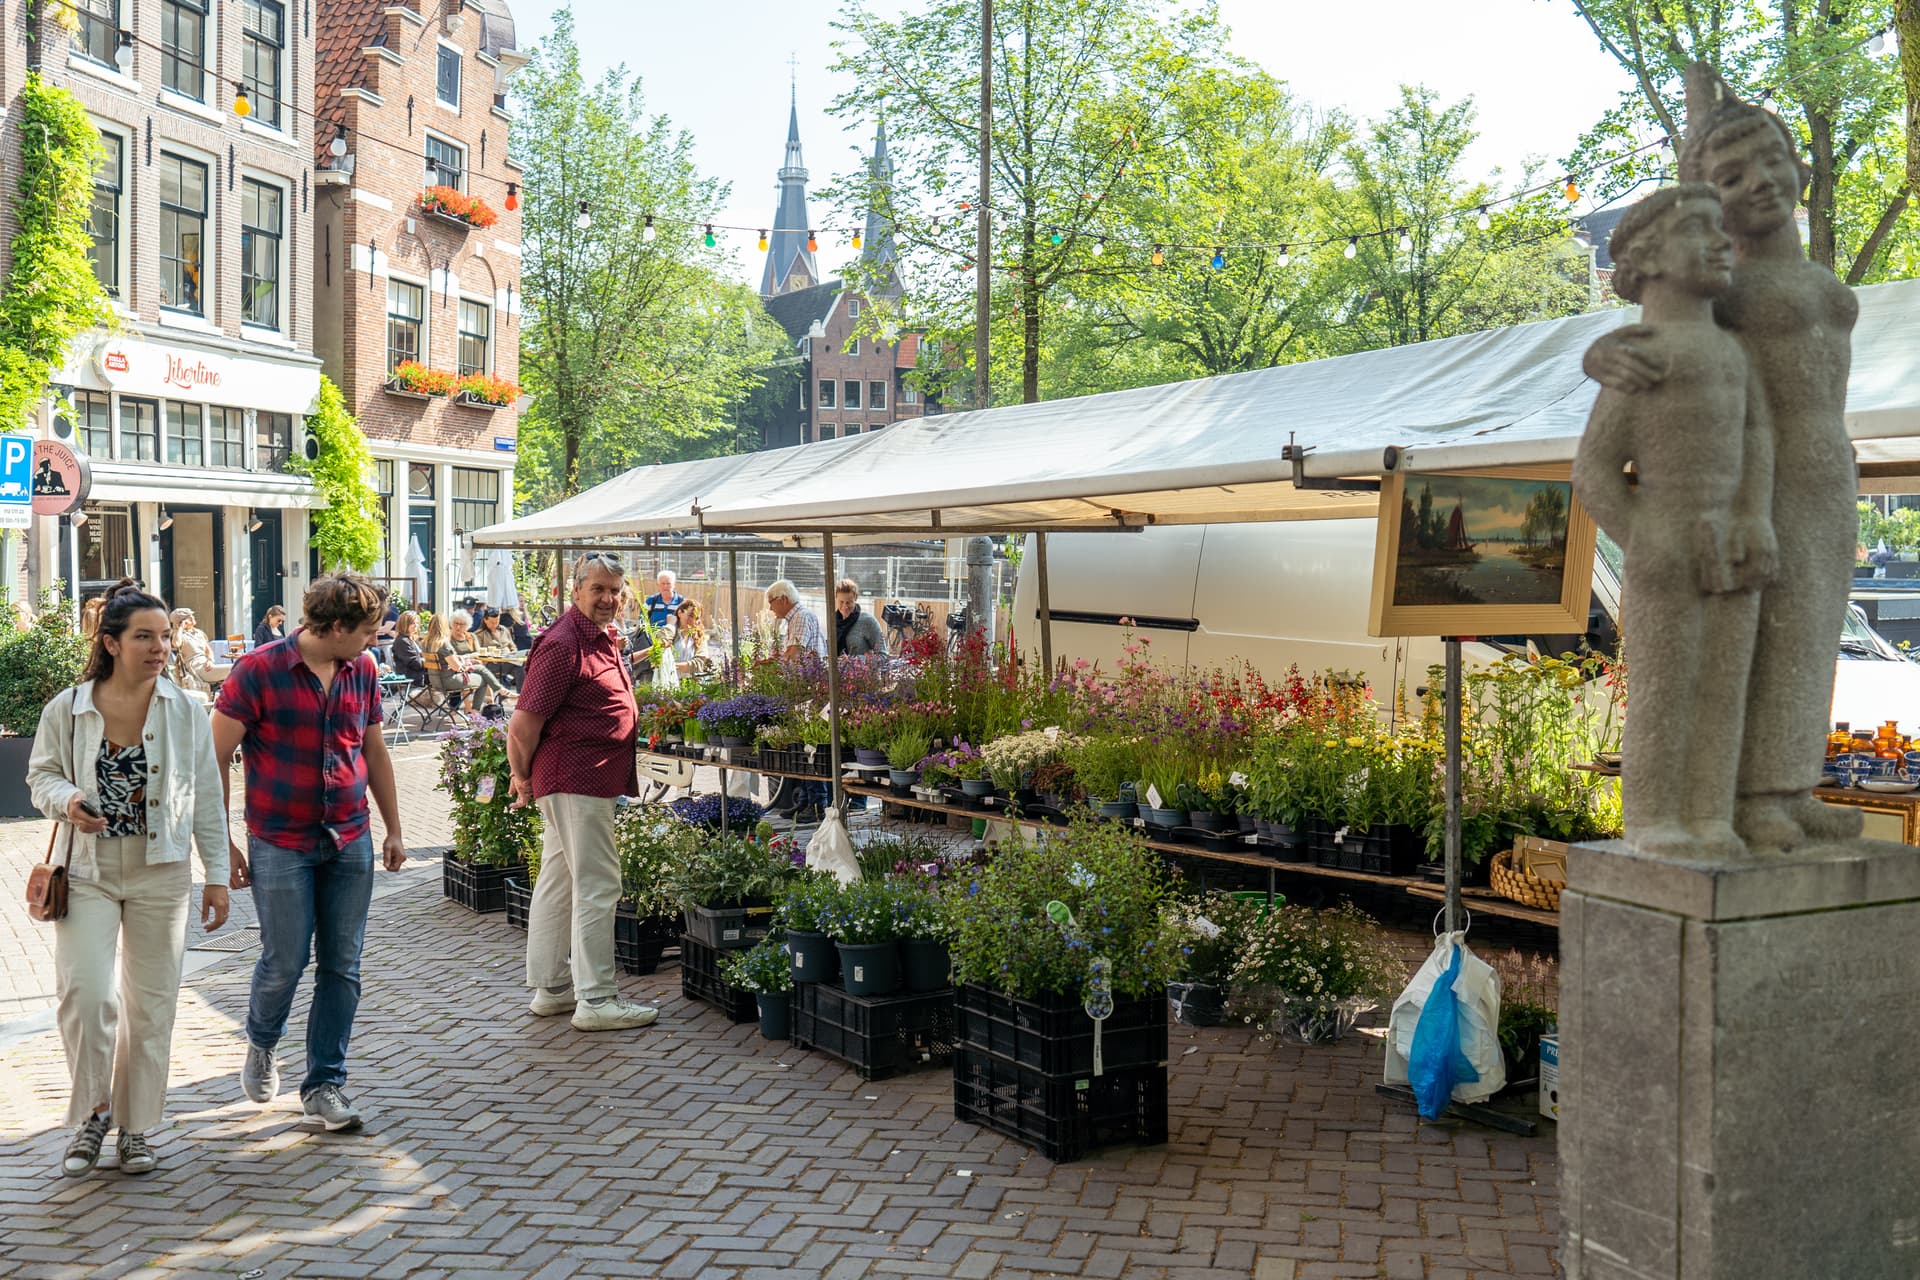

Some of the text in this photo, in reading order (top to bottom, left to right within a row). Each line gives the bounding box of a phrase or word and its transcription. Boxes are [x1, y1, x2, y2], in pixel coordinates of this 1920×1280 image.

[164, 353, 221, 389] Libertine
[5, 441, 26, 475] P
[38, 445, 54, 454] THE
[55, 449, 75, 471] JUICE
